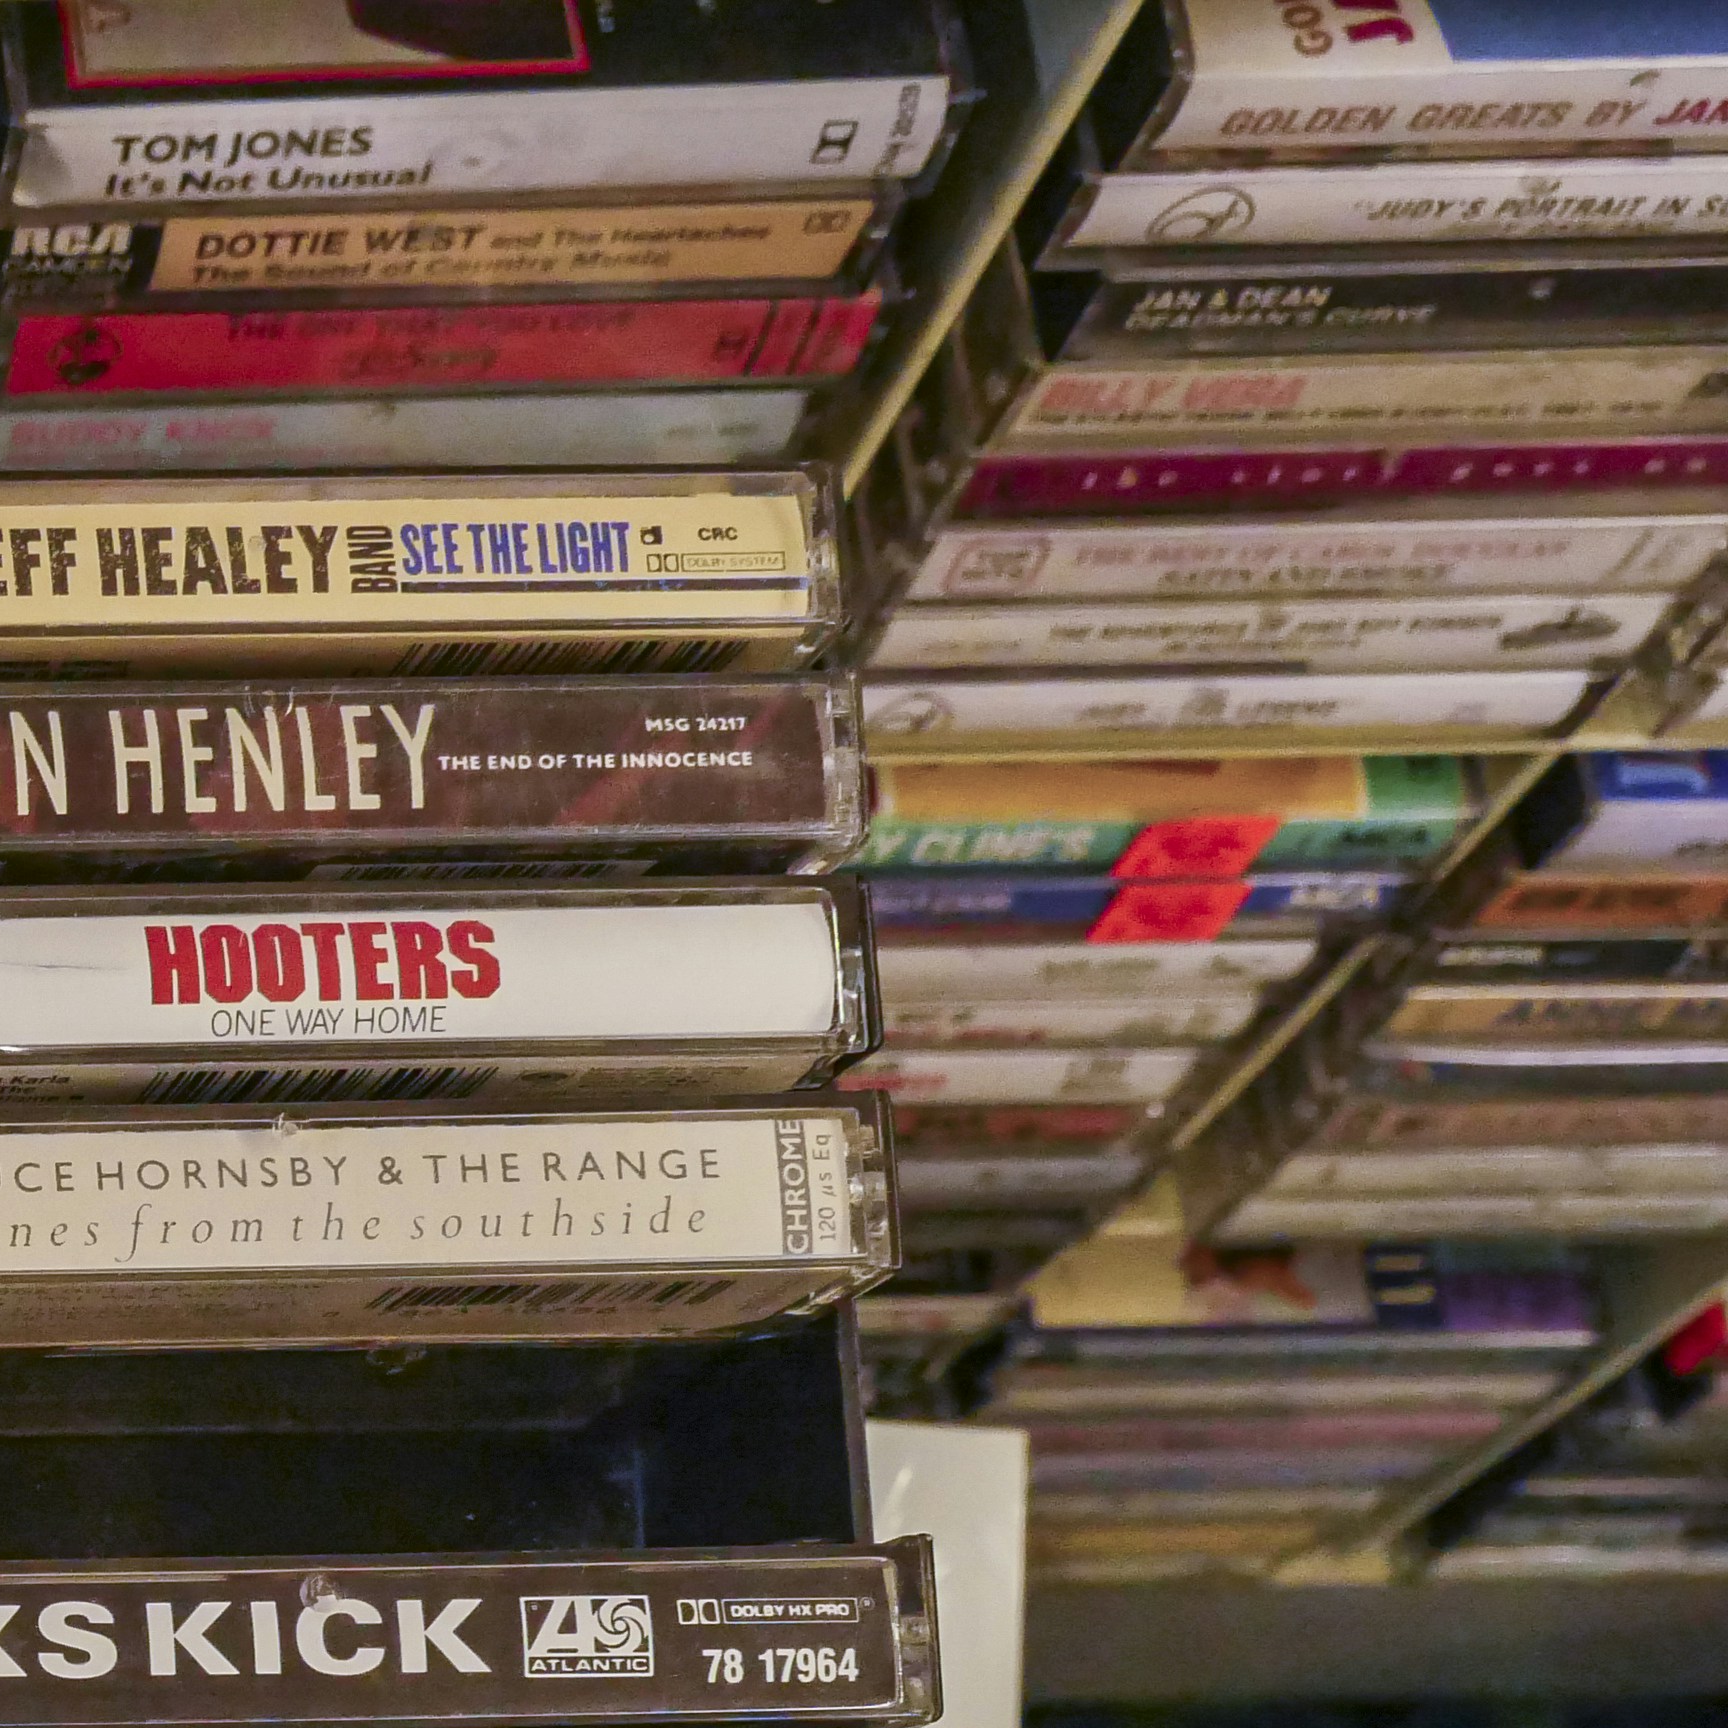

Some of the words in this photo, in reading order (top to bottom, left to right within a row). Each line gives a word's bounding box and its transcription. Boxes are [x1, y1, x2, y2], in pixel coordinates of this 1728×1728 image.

[1219, 103, 1397, 136] GOLDEN
[1406, 99, 1574, 132] GREATS
[112, 135, 218, 167] TOM
[226, 127, 374, 168] JONES
[104, 172, 169, 198] It's
[176, 169, 257, 196] Not
[269, 161, 431, 193] Unusual
[194, 231, 349, 261] DOTTIE
[365, 225, 488, 255] WEST
[95, 525, 339, 597] HEALEY
[400, 524, 474, 578] SEE
[466, 523, 542, 577] THE
[541, 522, 631, 575] LIGHT
[108, 704, 436, 815] HENLEY
[438, 755, 483, 772] THE
[488, 754, 533, 771] END
[537, 754, 567, 770] OF
[573, 753, 616, 770] THE
[621, 751, 753, 770] INNOCENCE
[143, 921, 502, 1006] HOOTERS
[95, 1155, 348, 1192] HORNSBY
[377, 1154, 406, 1187] &
[422, 1151, 523, 1184] THE
[543, 1148, 722, 1182] RANGE
[144, 1597, 493, 1677] KICK
